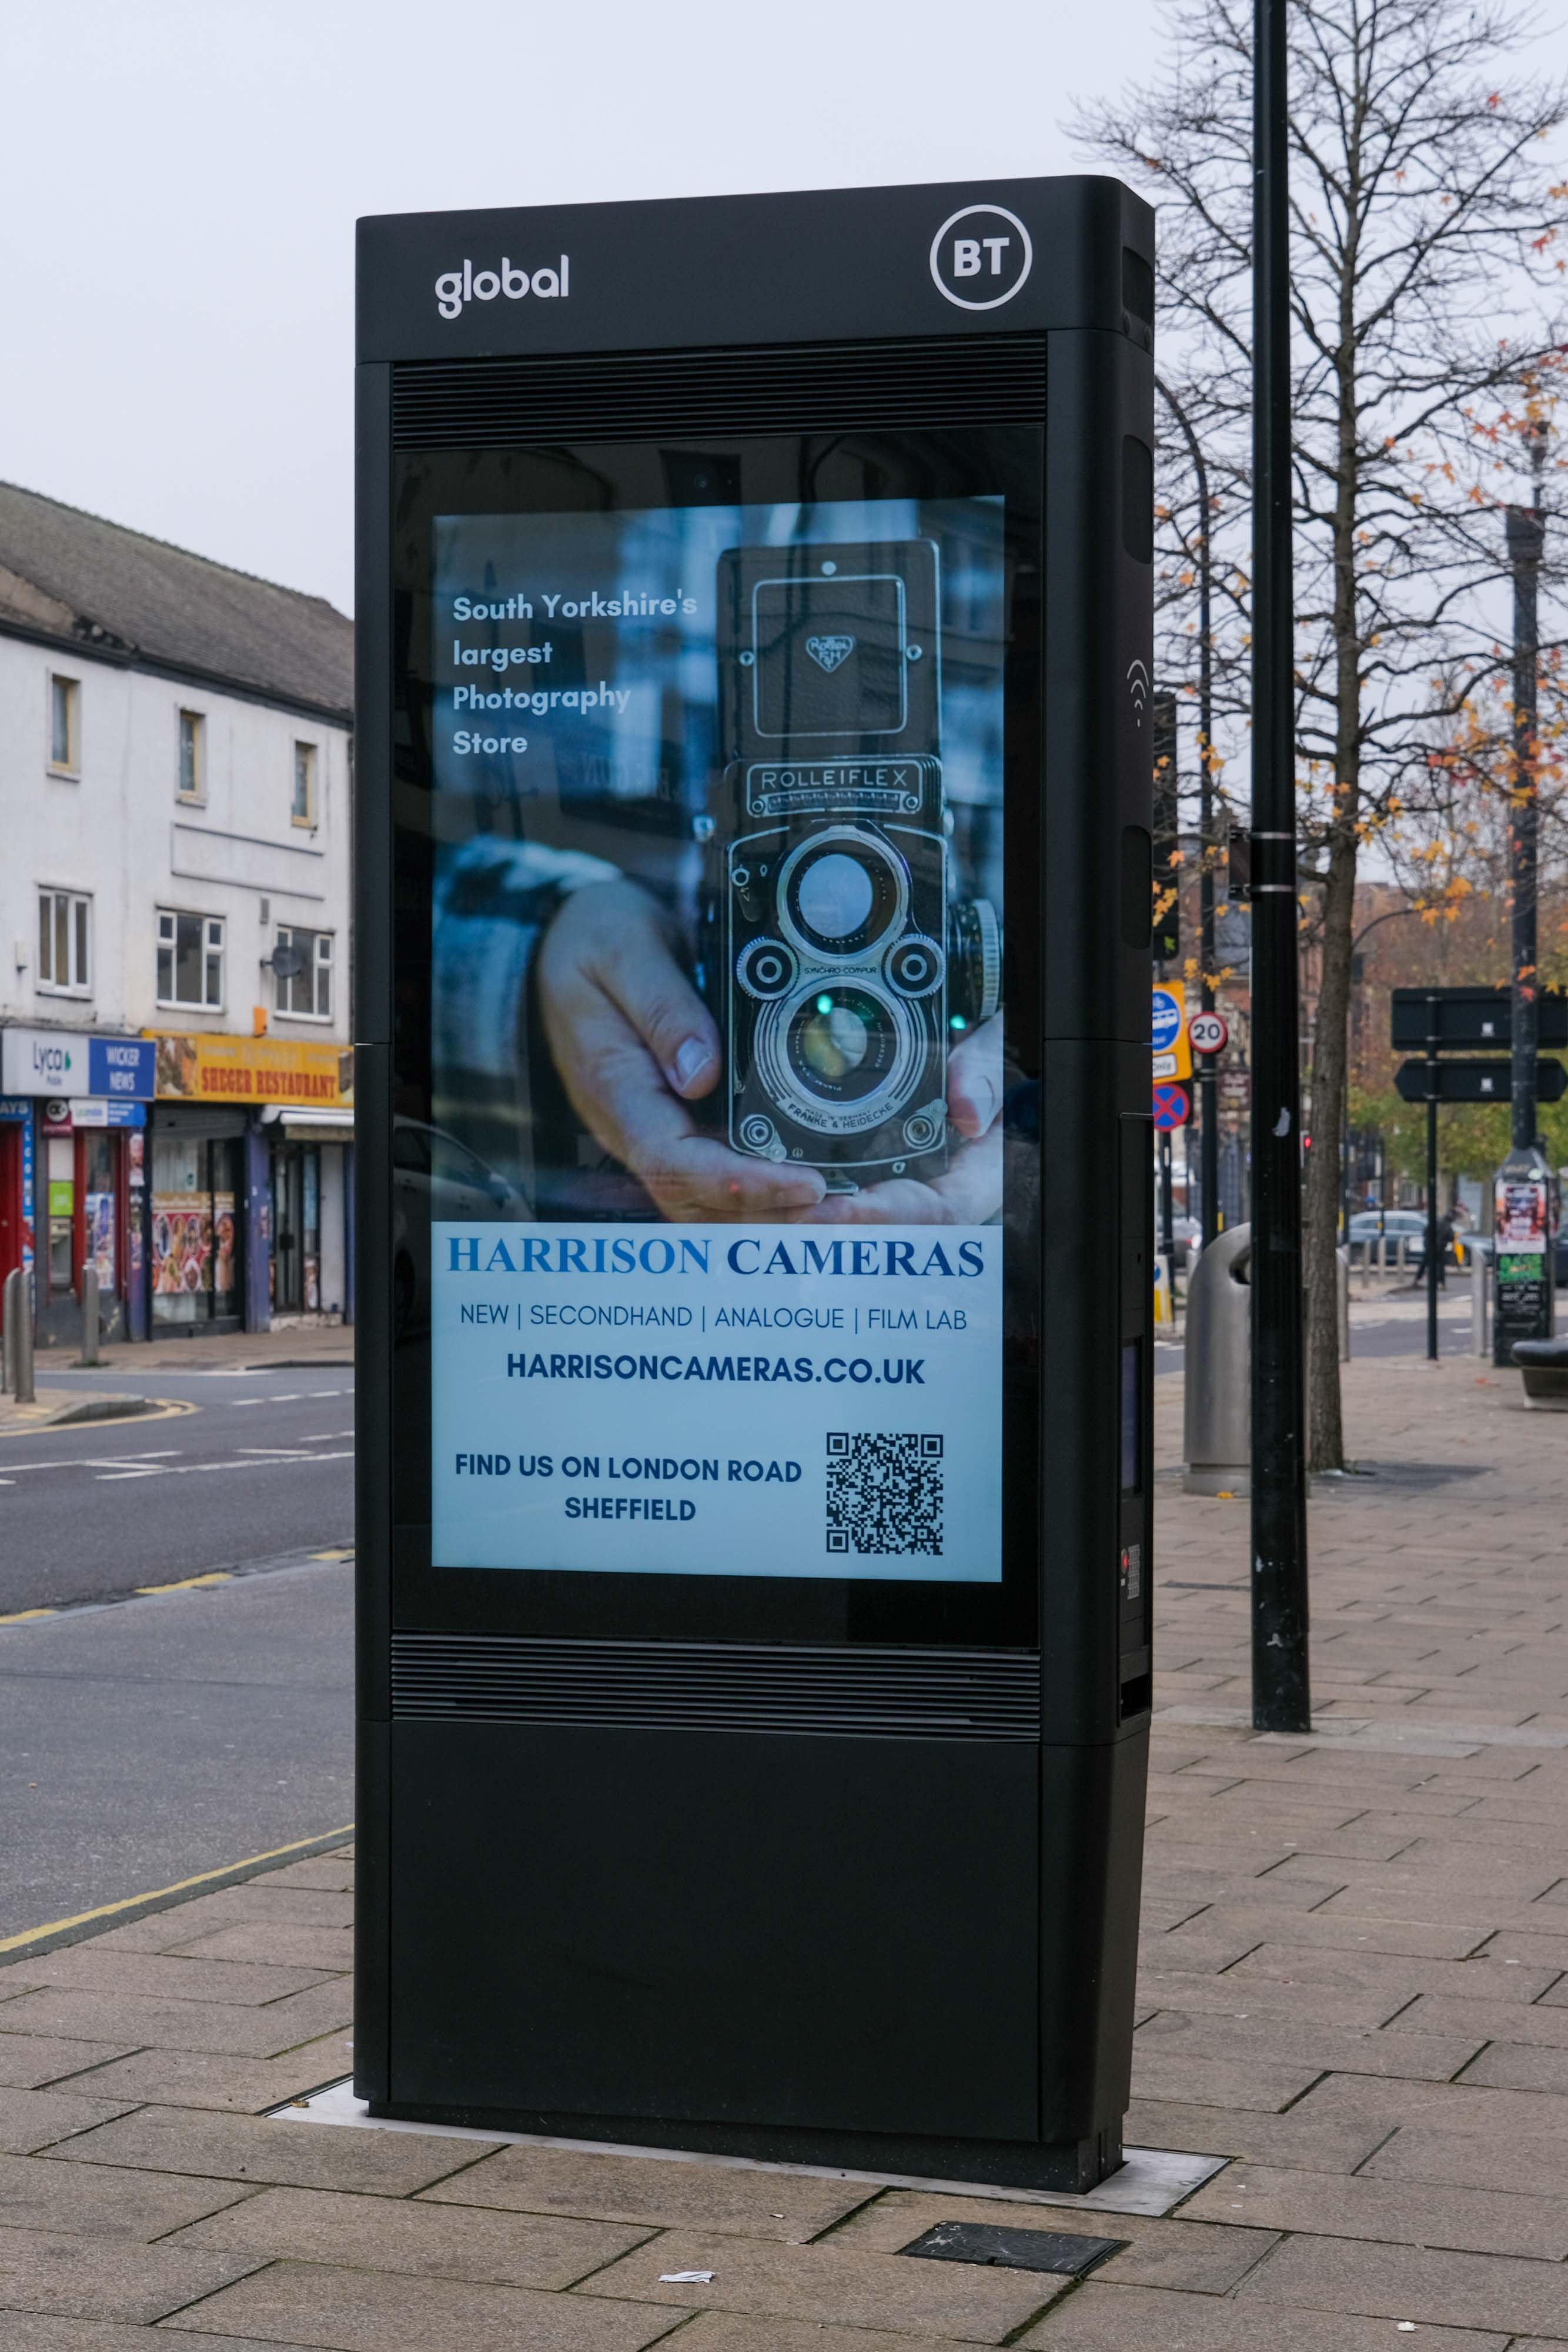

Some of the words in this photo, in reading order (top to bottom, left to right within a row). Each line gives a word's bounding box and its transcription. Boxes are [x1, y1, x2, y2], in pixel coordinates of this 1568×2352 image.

[954, 237, 1009, 277] BT
[434, 254, 569, 319] global
[453, 593, 533, 621] South
[541, 589, 697, 619] Yorkshire's
[453, 639, 553, 672] largest
[453, 680, 631, 716] Photography
[453, 730, 528, 755] Store
[762, 769, 907, 790] ROLLEIFLEX
[1193, 1023, 1221, 1040] 20
[106, 1045, 141, 1067] WICKER
[109, 1071, 135, 1091] NEWS
[202, 1066, 252, 1094] SHEGER
[256, 1070, 336, 1099] RESTAURANT
[787, 1103, 828, 1128] FRANKE
[842, 1102, 894, 1128] HEIDECKE
[446, 1237, 712, 1274] HARRISON
[727, 1239, 984, 1277] CAMERAS
[461, 1304, 509, 1324] NEW
[530, 1304, 693, 1327] SECONDHAND
[714, 1307, 844, 1328] ANALOGUE
[868, 1309, 918, 1329] FILM
[926, 1309, 967, 1330] LAB
[507, 1353, 926, 1384] HARRISONCAMERAS.CO.UK
[456, 1454, 511, 1476] FIND
[519, 1455, 554, 1477] US
[561, 1456, 600, 1478] ON
[609, 1457, 718, 1481] LONDON
[728, 1460, 802, 1482] ROAD
[564, 1496, 696, 1521] SHEFFIELD
